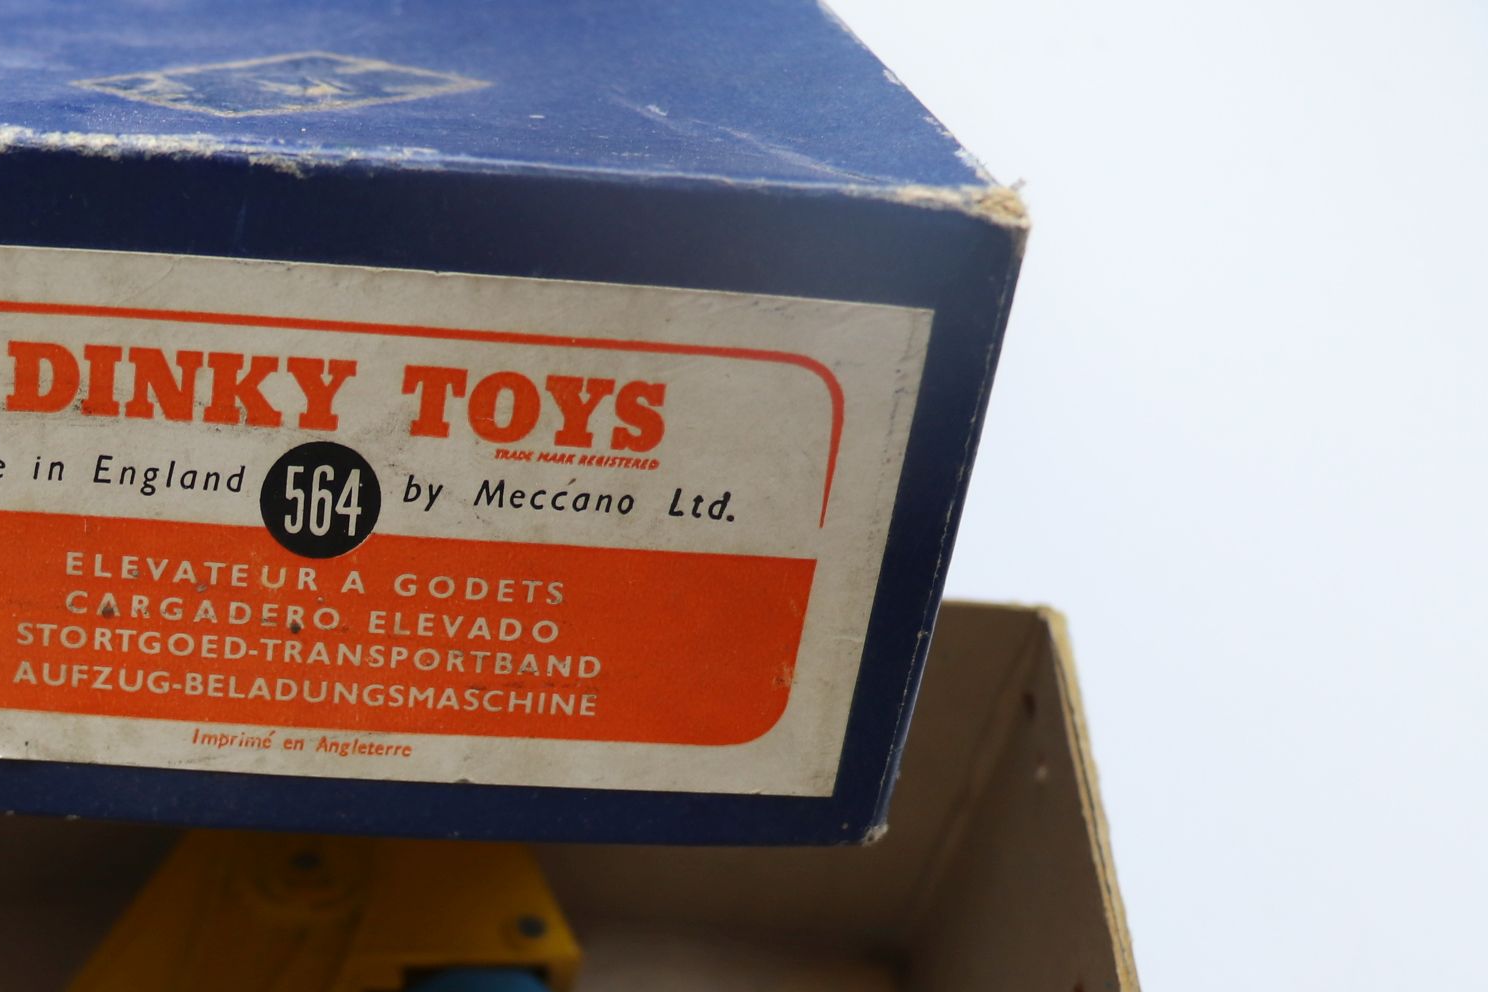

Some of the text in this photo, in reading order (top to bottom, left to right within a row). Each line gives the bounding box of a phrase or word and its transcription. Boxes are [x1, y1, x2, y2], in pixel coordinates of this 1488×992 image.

[4, 338, 667, 453] DINKY TOYS
[32, 461, 65, 481] in
[93, 454, 246, 497] England
[284, 464, 362, 537] 564
[402, 474, 444, 512] by
[668, 487, 735, 523] Ltd.
[66, 551, 563, 604] ELEVATEUR A GODETS
[65, 590, 559, 643] CARGADERO ELEVADO
[15, 621, 602, 680] STORTGOED-TRANSPORTBAND
[13, 660, 598, 717] AUFZUG-BELADUNGSMASCHINE
[191, 727, 416, 758] Imprimé en Angleterre
